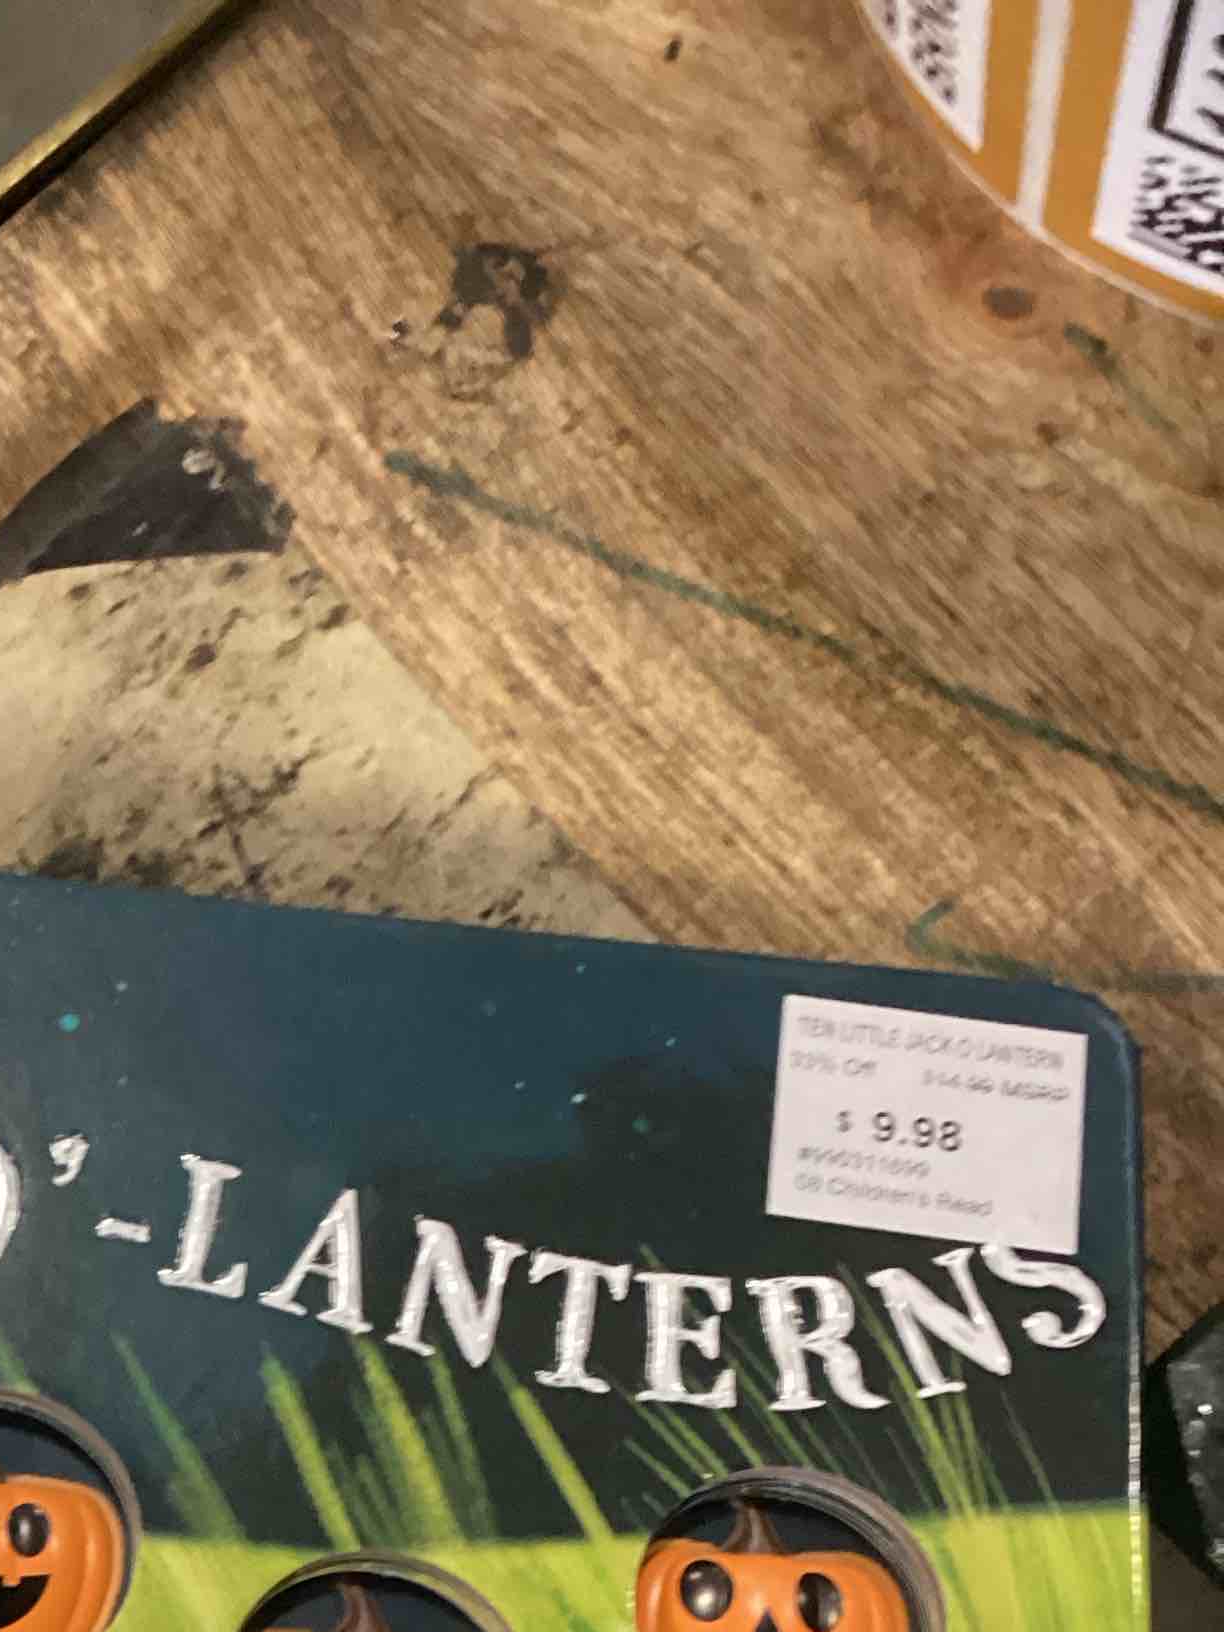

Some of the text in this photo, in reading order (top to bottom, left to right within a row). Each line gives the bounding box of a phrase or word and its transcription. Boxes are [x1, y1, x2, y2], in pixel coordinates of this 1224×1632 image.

[839, 1022, 900, 1050] LITTLE
[836, 1110, 963, 1152] $ 9.98
